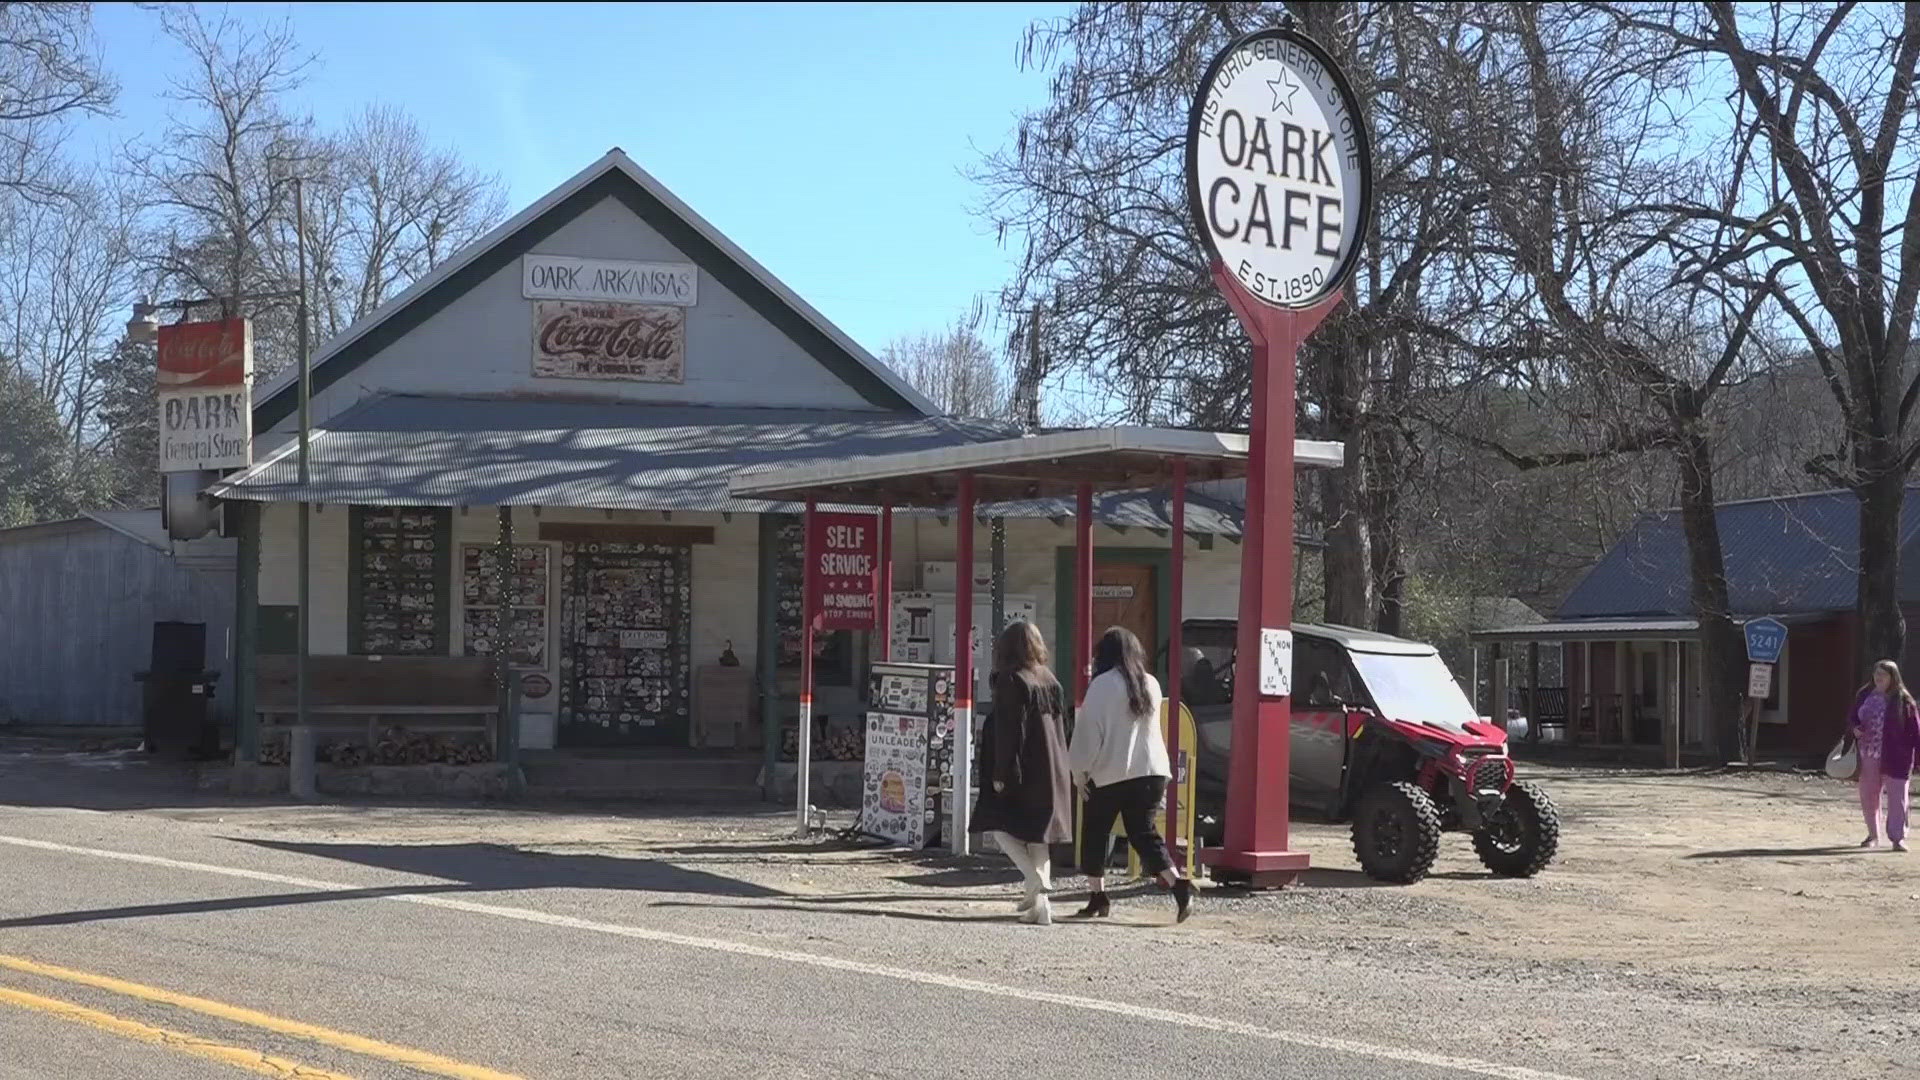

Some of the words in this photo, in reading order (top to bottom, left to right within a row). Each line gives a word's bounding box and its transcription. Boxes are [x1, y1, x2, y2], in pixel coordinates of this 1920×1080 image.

[1199, 46, 1253, 138] HISTORIC
[1253, 39, 1326, 90] GENERAL
[1327, 86, 1361, 172] STORE
[1217, 109, 1336, 188] OARK
[1208, 176, 1342, 261] CAFE
[592, 268, 691, 299] ARKANSAS
[165, 393, 242, 431] OARK
[165, 435, 211, 461] General
[213, 433, 244, 459] Store
[826, 525, 864, 549] SELF
[820, 553, 871, 576] SERVICE
[823, 594, 835, 607] NO
[835, 593, 874, 608] SMOKING
[621, 631, 641, 640] EXIT
[643, 631, 665, 640] ONLY
[1276, 640, 1291, 650] NON
[1750, 634, 1778, 649] 5241
